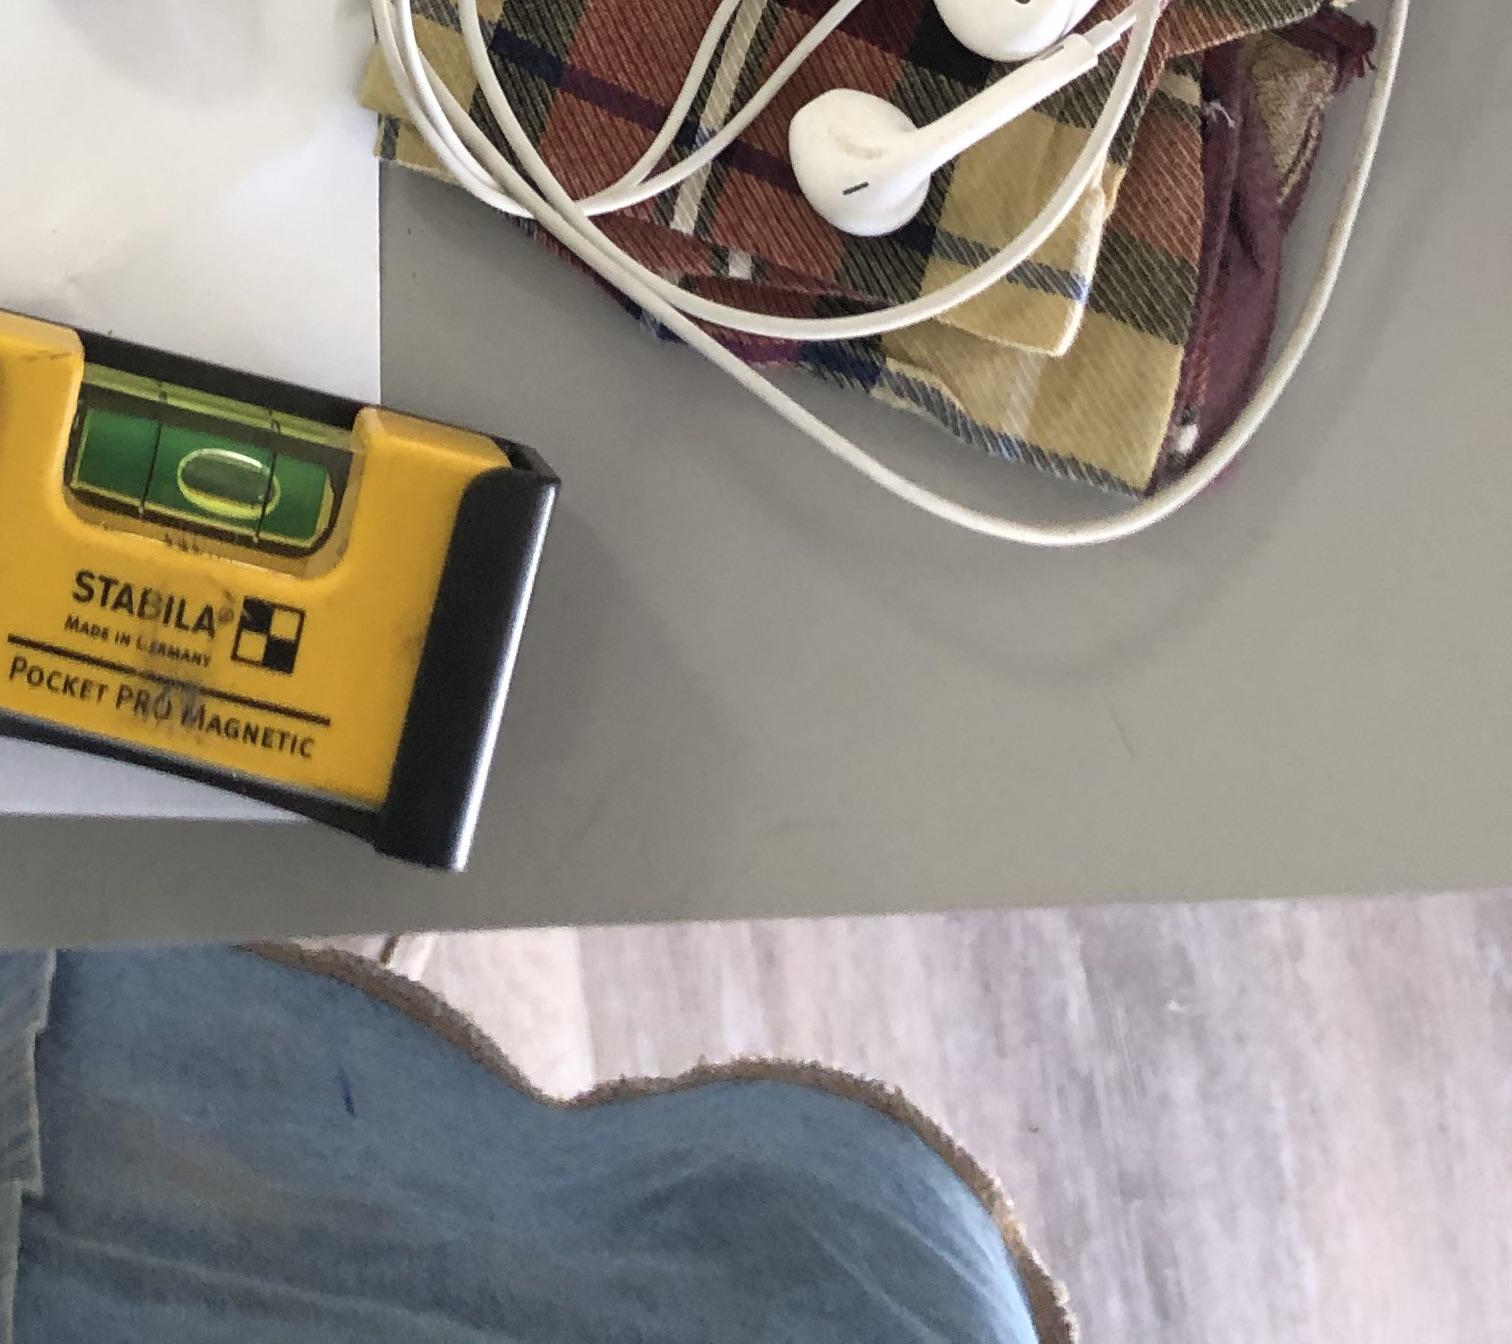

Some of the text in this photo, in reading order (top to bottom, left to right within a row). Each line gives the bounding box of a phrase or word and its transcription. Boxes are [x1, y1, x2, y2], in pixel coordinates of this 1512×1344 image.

[64, 613, 110, 643] MADE
[113, 628, 131, 647] IN
[71, 568, 218, 640] STABILA
[7, 653, 317, 761] POCKET PRO MAGNETIC
